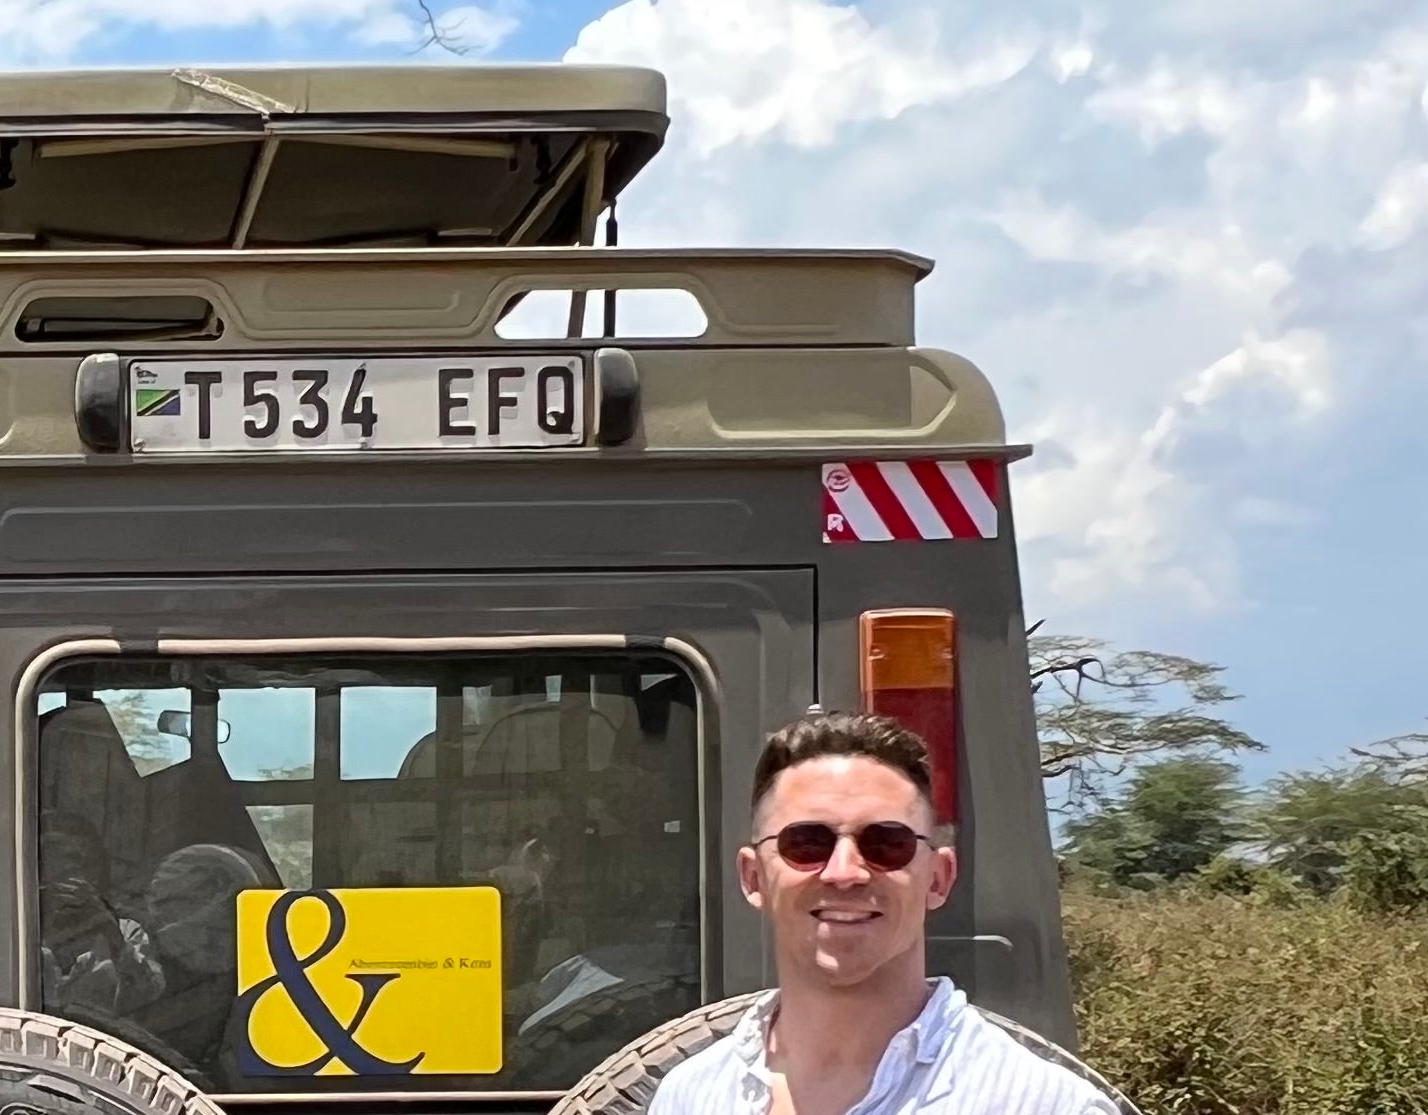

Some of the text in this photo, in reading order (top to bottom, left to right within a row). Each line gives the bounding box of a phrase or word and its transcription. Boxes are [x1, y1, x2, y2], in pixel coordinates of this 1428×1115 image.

[183, 365, 576, 440] T 534 EFQ
